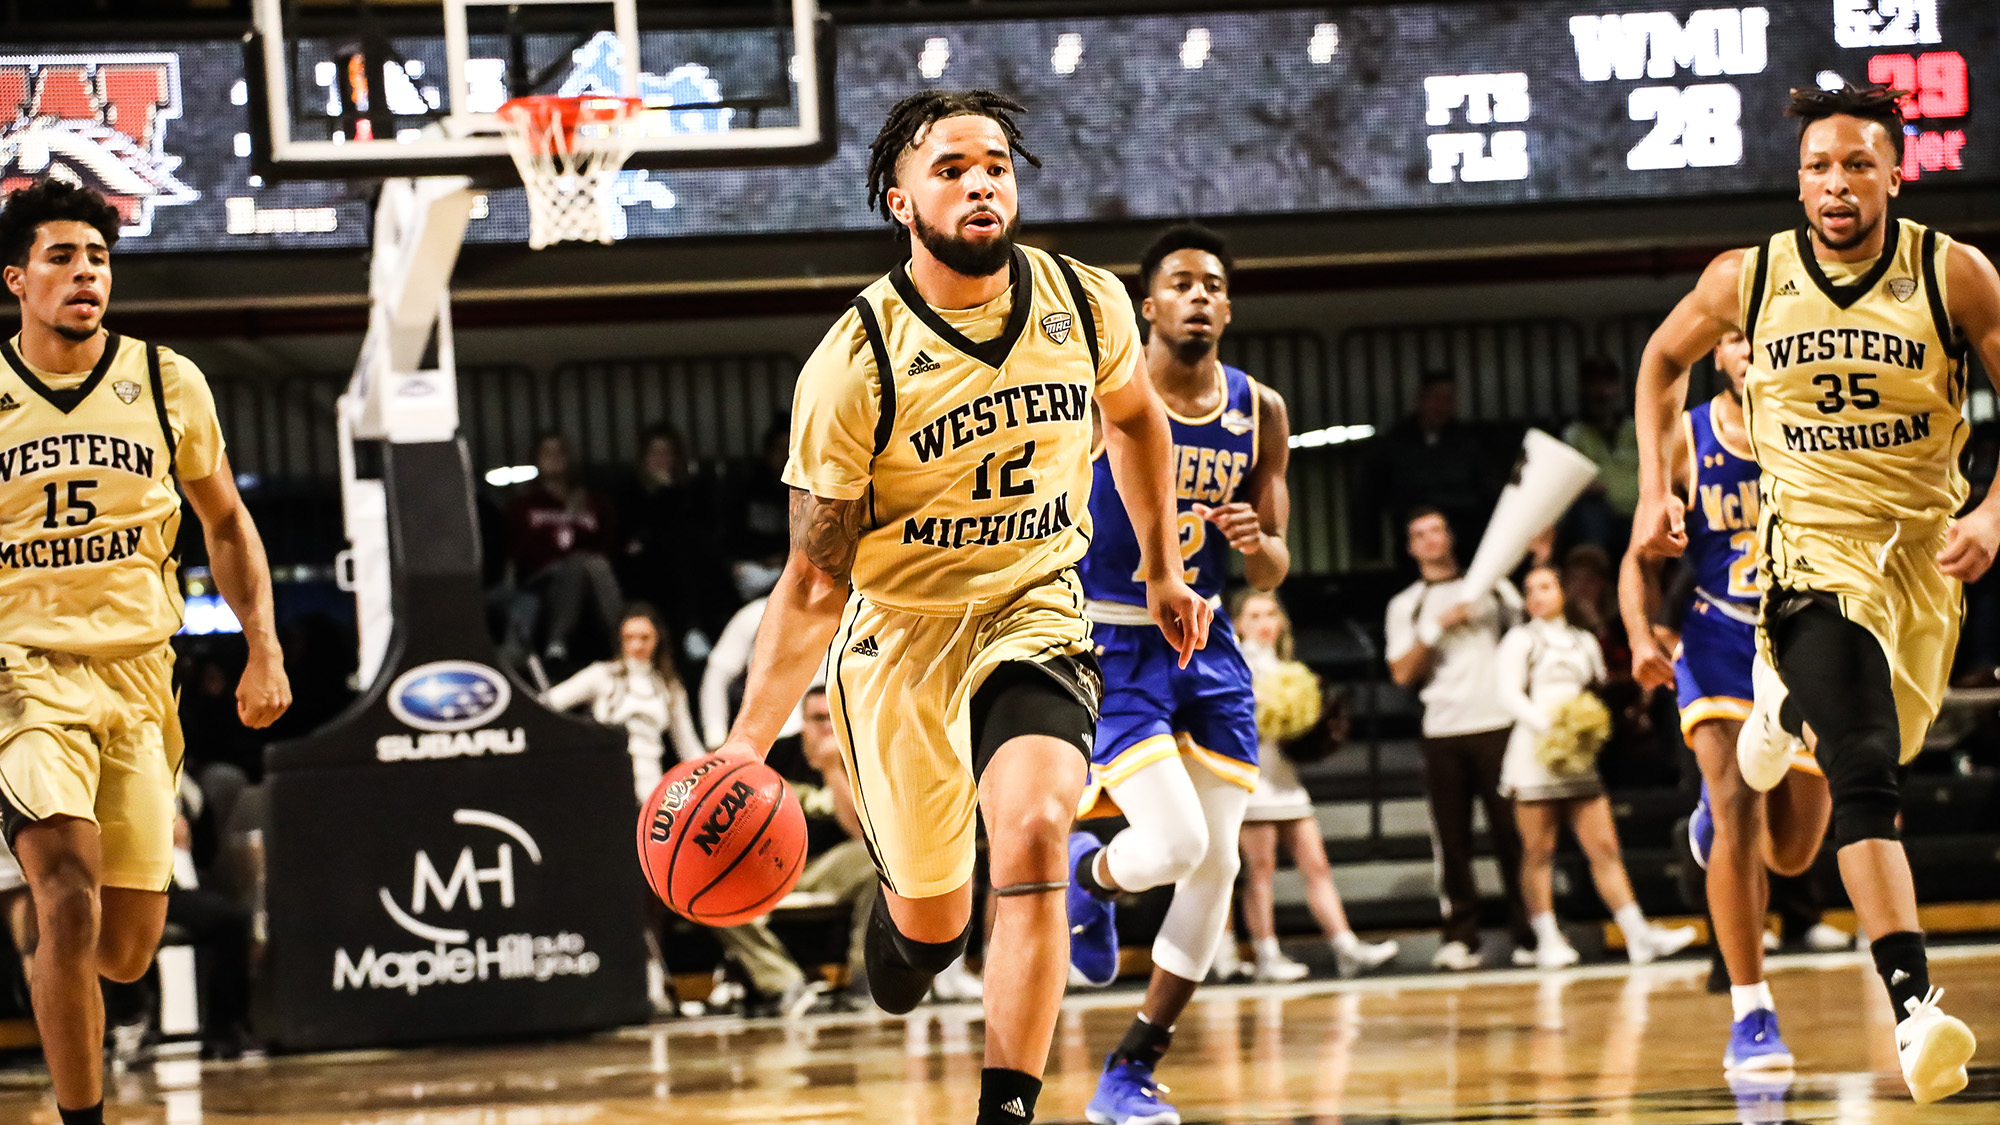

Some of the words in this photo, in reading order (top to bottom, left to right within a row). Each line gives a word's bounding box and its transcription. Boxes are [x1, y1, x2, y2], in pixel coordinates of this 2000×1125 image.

[1569, 7, 1770, 82] WMU
[1424, 73, 1529, 126] PTS
[1627, 83, 1743, 170] 28
[1427, 130, 1528, 183] FLS
[1045, 320, 1070, 333] MAC
[1766, 328, 1926, 371] WESTERN
[907, 362, 941, 376] adidas
[1811, 373, 1880, 414] 35
[909, 383, 1087, 464] WESTERN
[1781, 412, 1931, 453] MICHIGAN
[972, 440, 1036, 500] 12
[43, 480, 98, 528] 15
[901, 491, 1073, 549] MICHIGAN
[376, 727, 527, 762] SUBARU
[650, 758, 726, 844] Wilson
[693, 780, 757, 857] NCAA
[411, 842, 515, 915] MH
